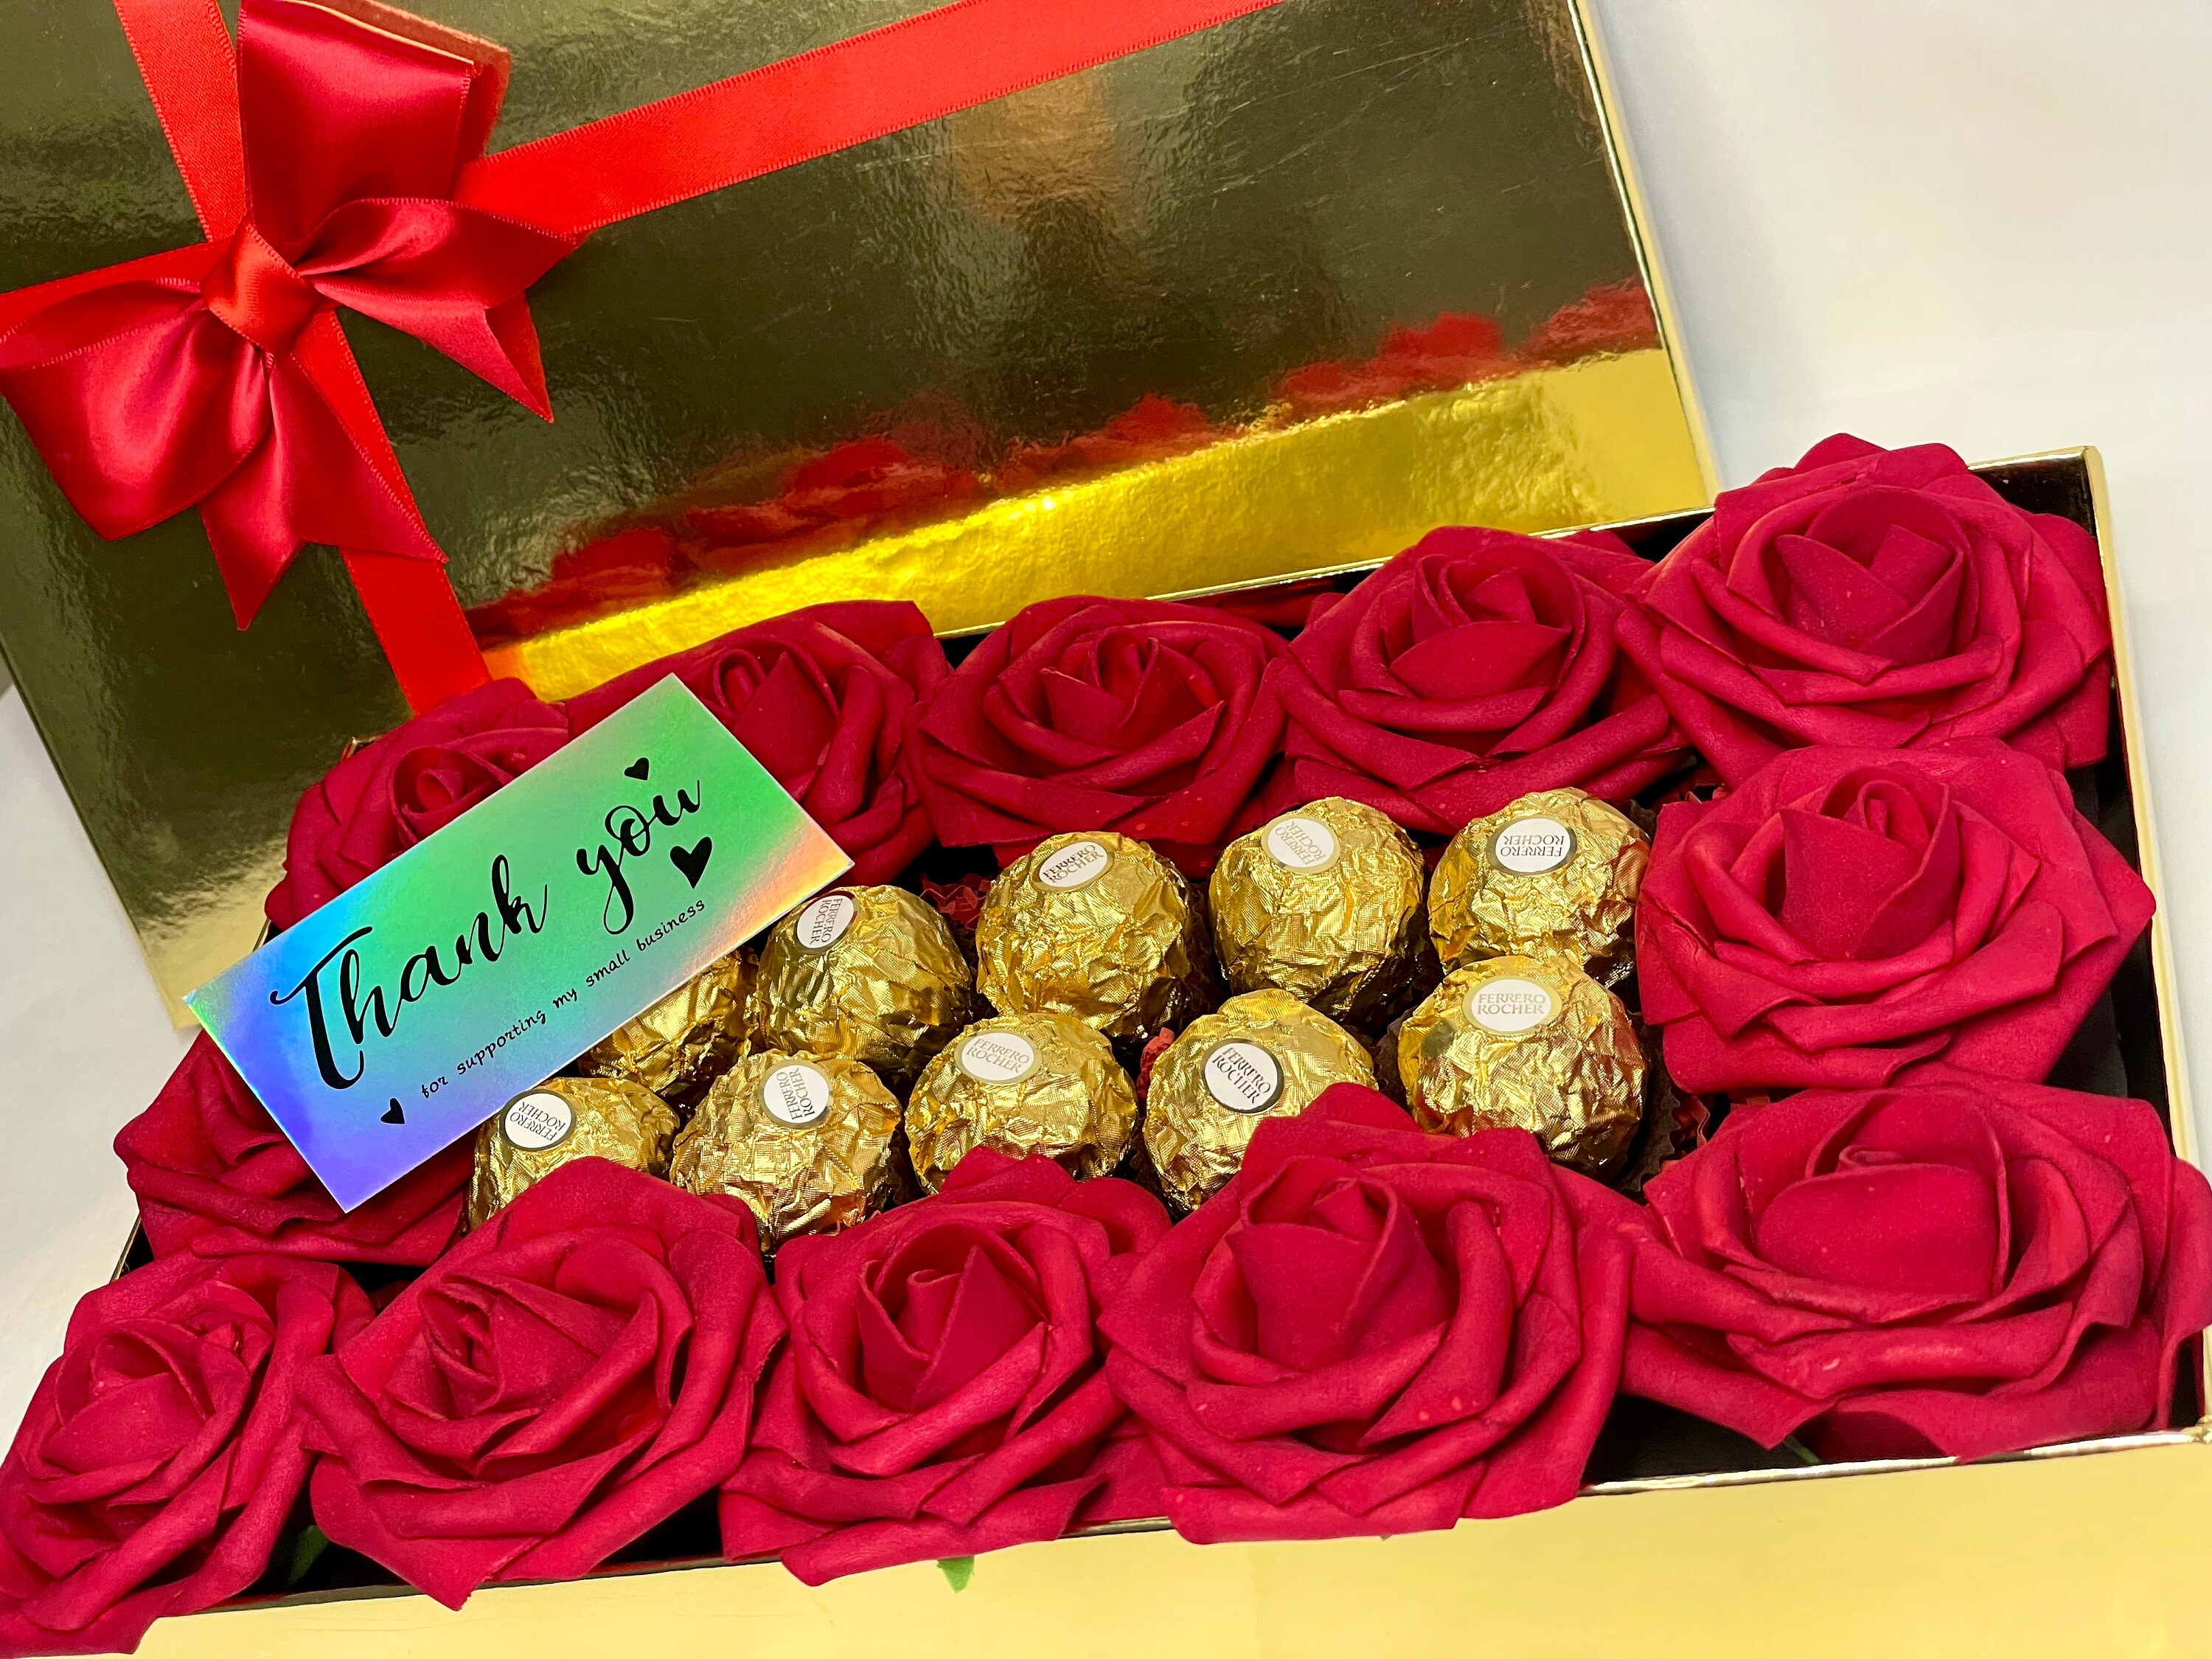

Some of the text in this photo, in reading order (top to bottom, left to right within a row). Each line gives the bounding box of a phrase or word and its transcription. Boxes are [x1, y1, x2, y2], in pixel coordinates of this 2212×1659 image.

[1275, 827, 1315, 865] FERRERO
[1286, 821, 1326, 860] ROCHER
[1500, 846, 1562, 857] FERRERO
[1503, 835, 1564, 845] ROCHER
[1043, 844, 1096, 878] FERRERO
[1048, 851, 1104, 883] ROCHER
[270, 779, 701, 1089] Thank you
[810, 900, 832, 945] ROCHER
[821, 899, 843, 943] FERRERO
[421, 900, 705, 1099] for supporting my small business
[1477, 1004, 1545, 1015] ROCHER
[1478, 993, 1546, 1004] FERRERO
[965, 1046, 1021, 1073] ROCHER
[973, 1038, 1029, 1063] FERRERO
[1212, 1054, 1259, 1104] ROCHER
[1222, 1047, 1270, 1093] FERRERO
[776, 1071, 803, 1120] FERRERO
[789, 1067, 815, 1116] ROCHER
[509, 1112, 557, 1141] FERRERO
[518, 1101, 566, 1132] ROCHER
